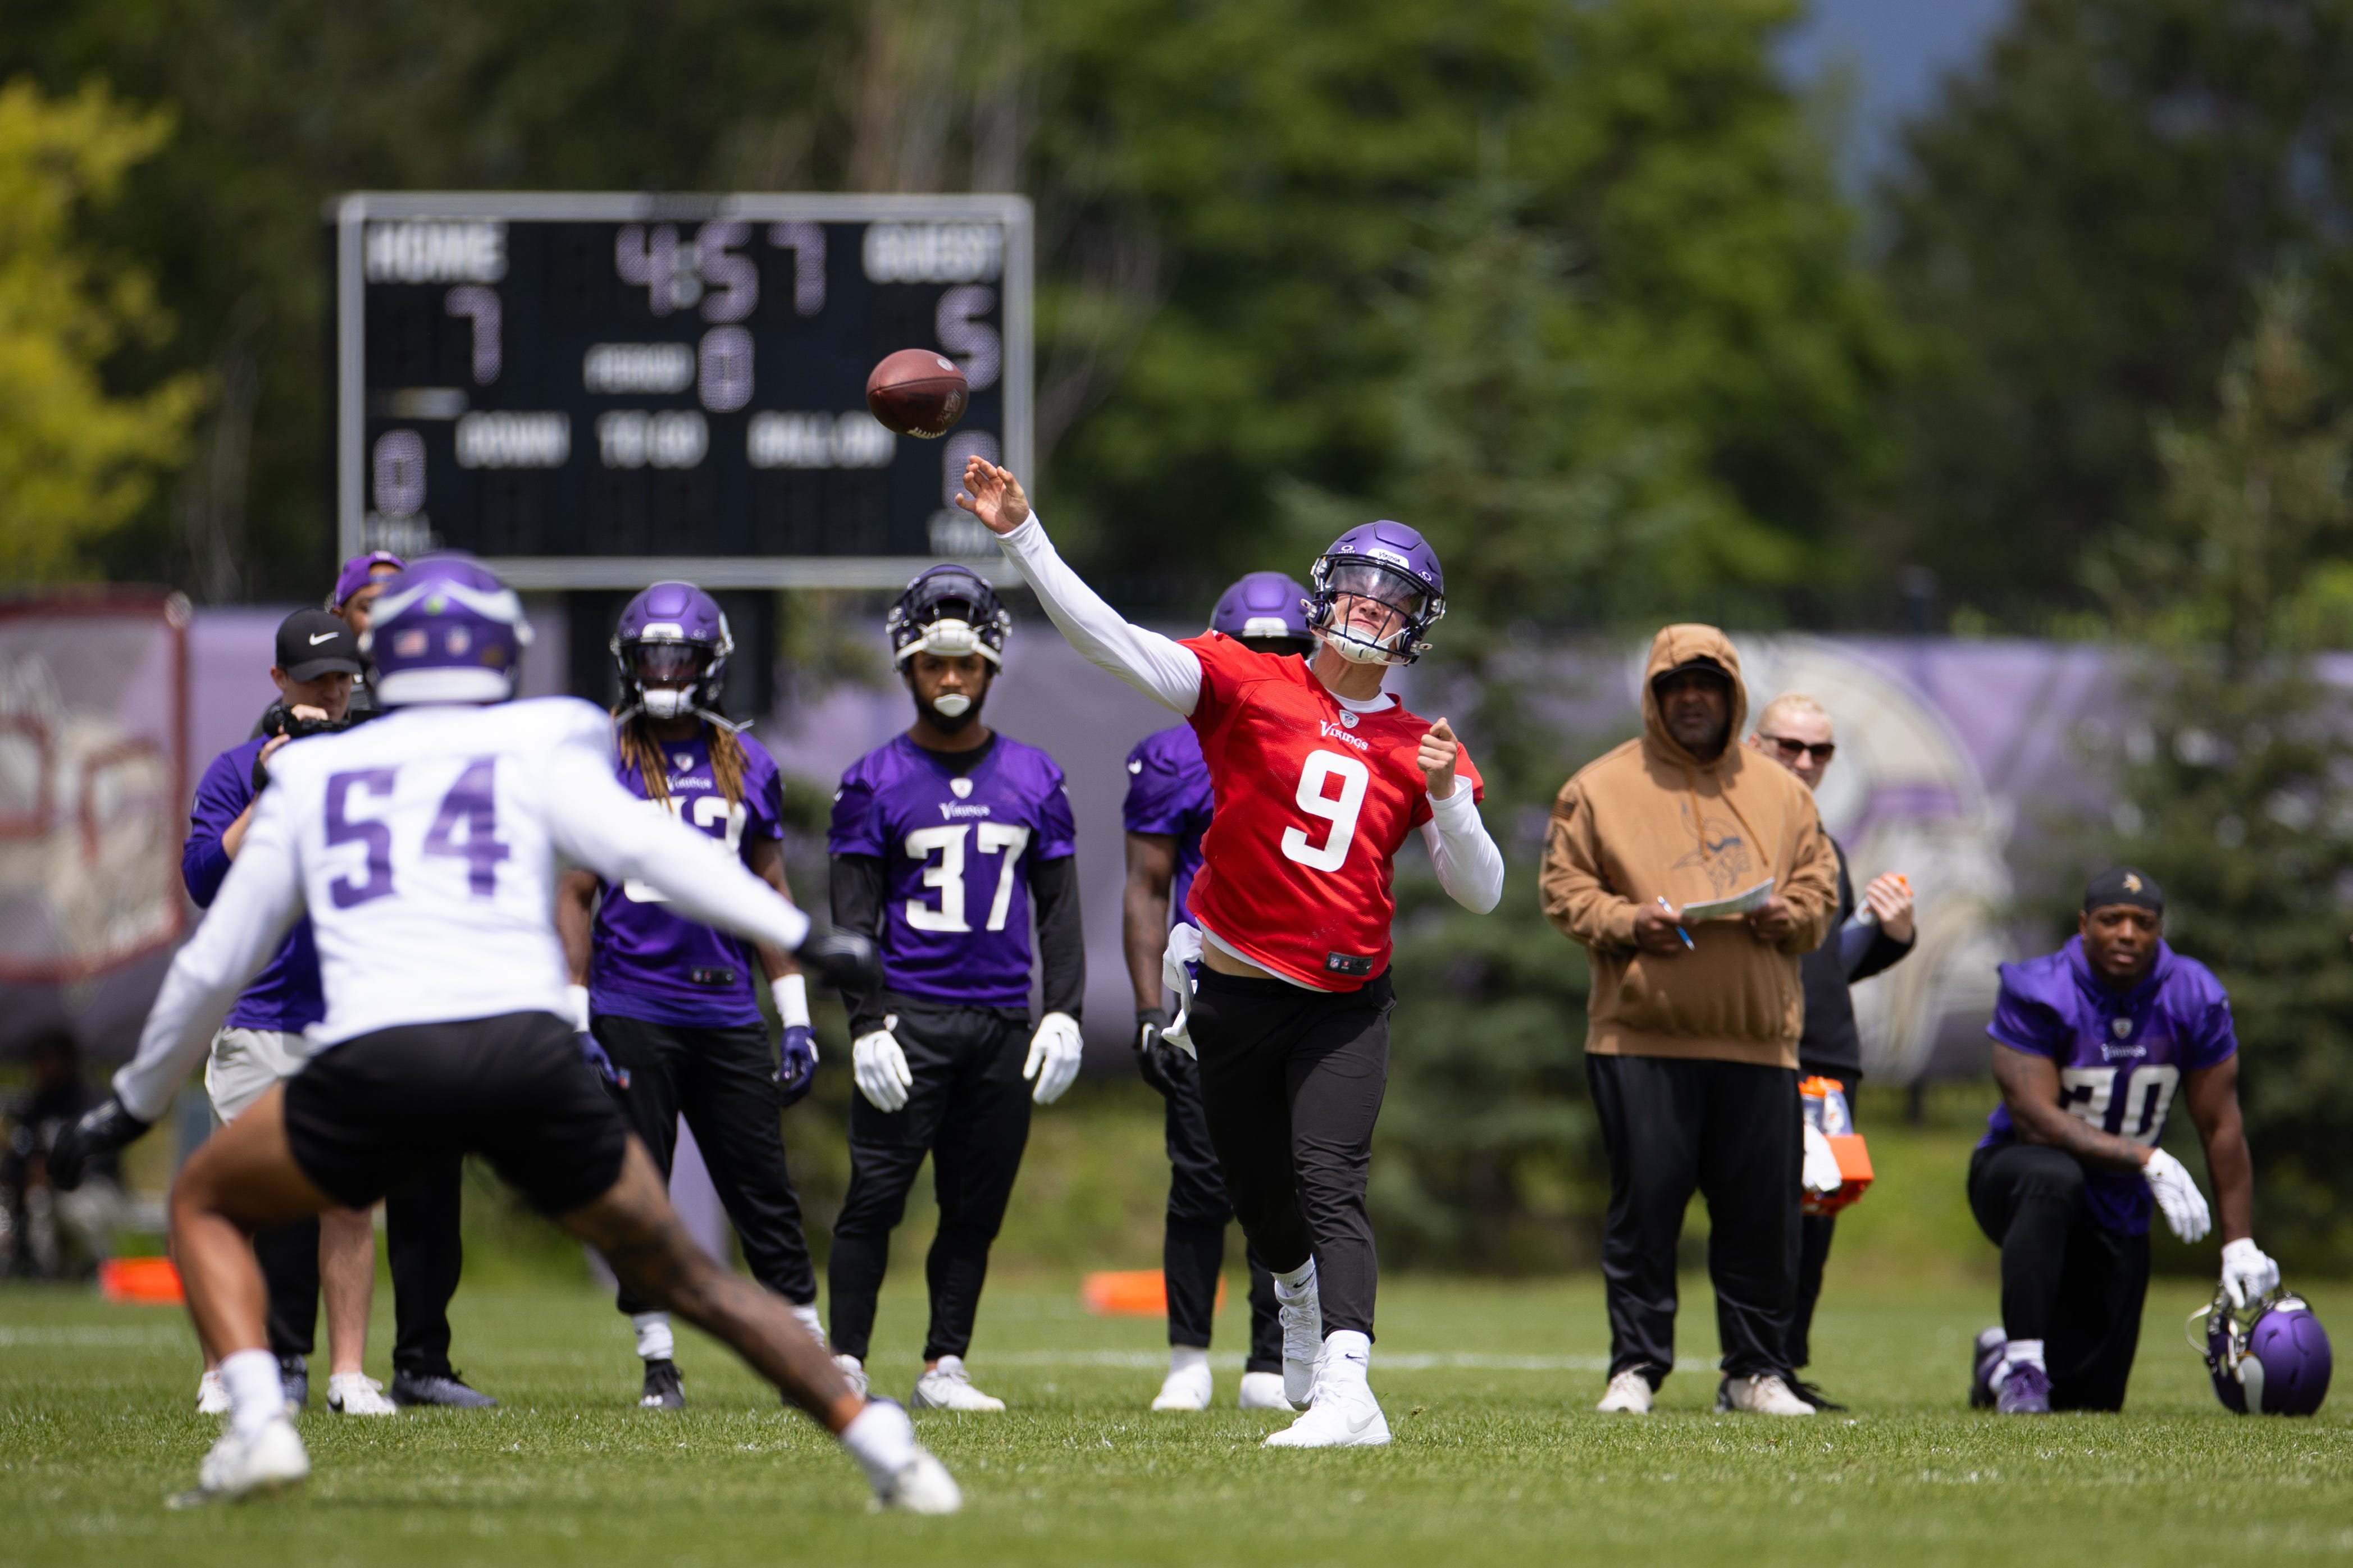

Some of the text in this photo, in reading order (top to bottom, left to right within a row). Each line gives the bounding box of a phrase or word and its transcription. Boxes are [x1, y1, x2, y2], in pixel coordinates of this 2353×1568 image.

[616, 221, 827, 323] 4:57
[446, 285, 501, 386] 7
[936, 285, 1001, 391] 5
[327, 754, 509, 909] 54
[1282, 750, 1369, 872] 9
[905, 822, 1030, 932] 37
